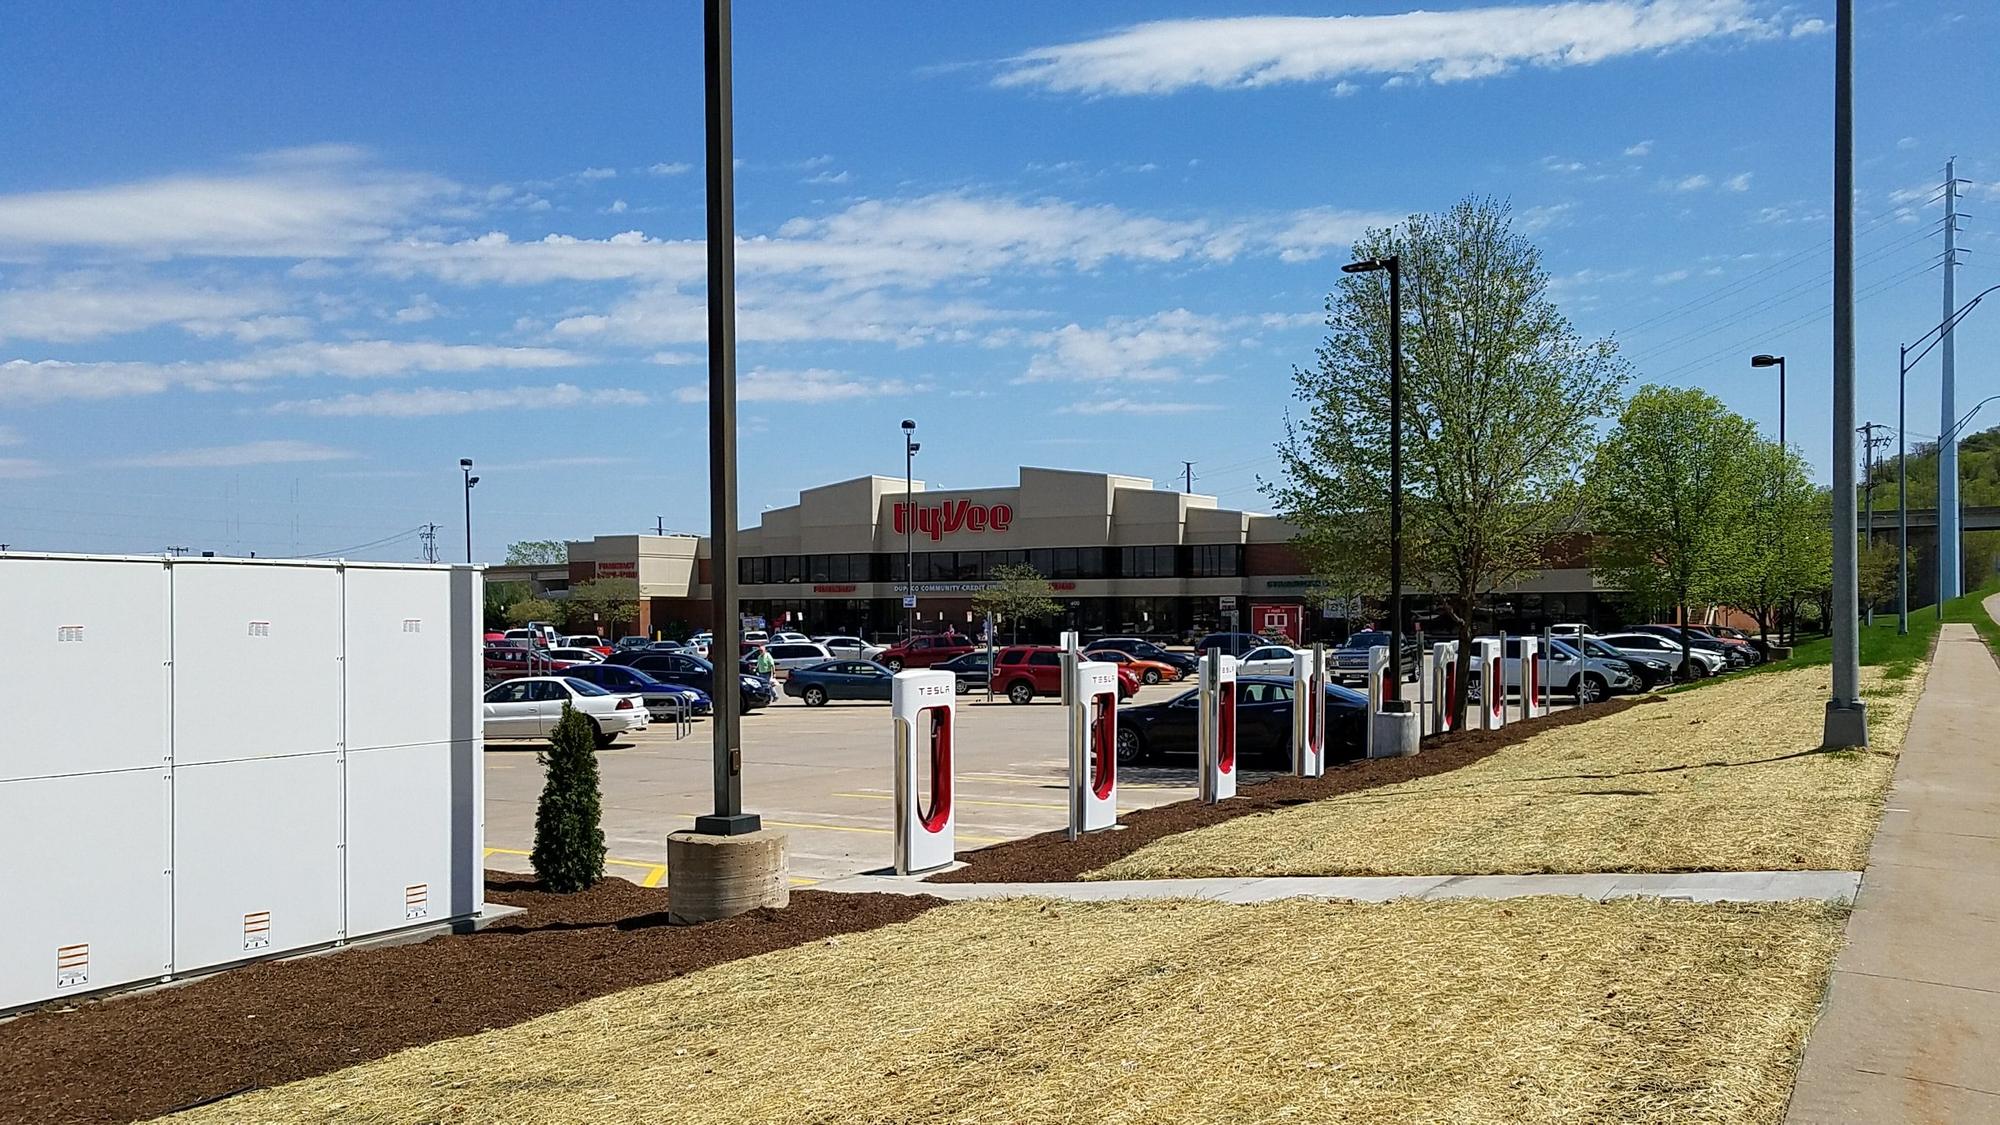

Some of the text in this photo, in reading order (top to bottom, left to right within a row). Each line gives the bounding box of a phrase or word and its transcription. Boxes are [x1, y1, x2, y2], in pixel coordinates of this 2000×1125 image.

[894, 584, 919, 592] DUPCO
[920, 583, 960, 592] COMMUNITY
[961, 583, 985, 591] CREDIT
[1092, 674, 1115, 684] TESLA
[918, 685, 949, 696] TESLA
